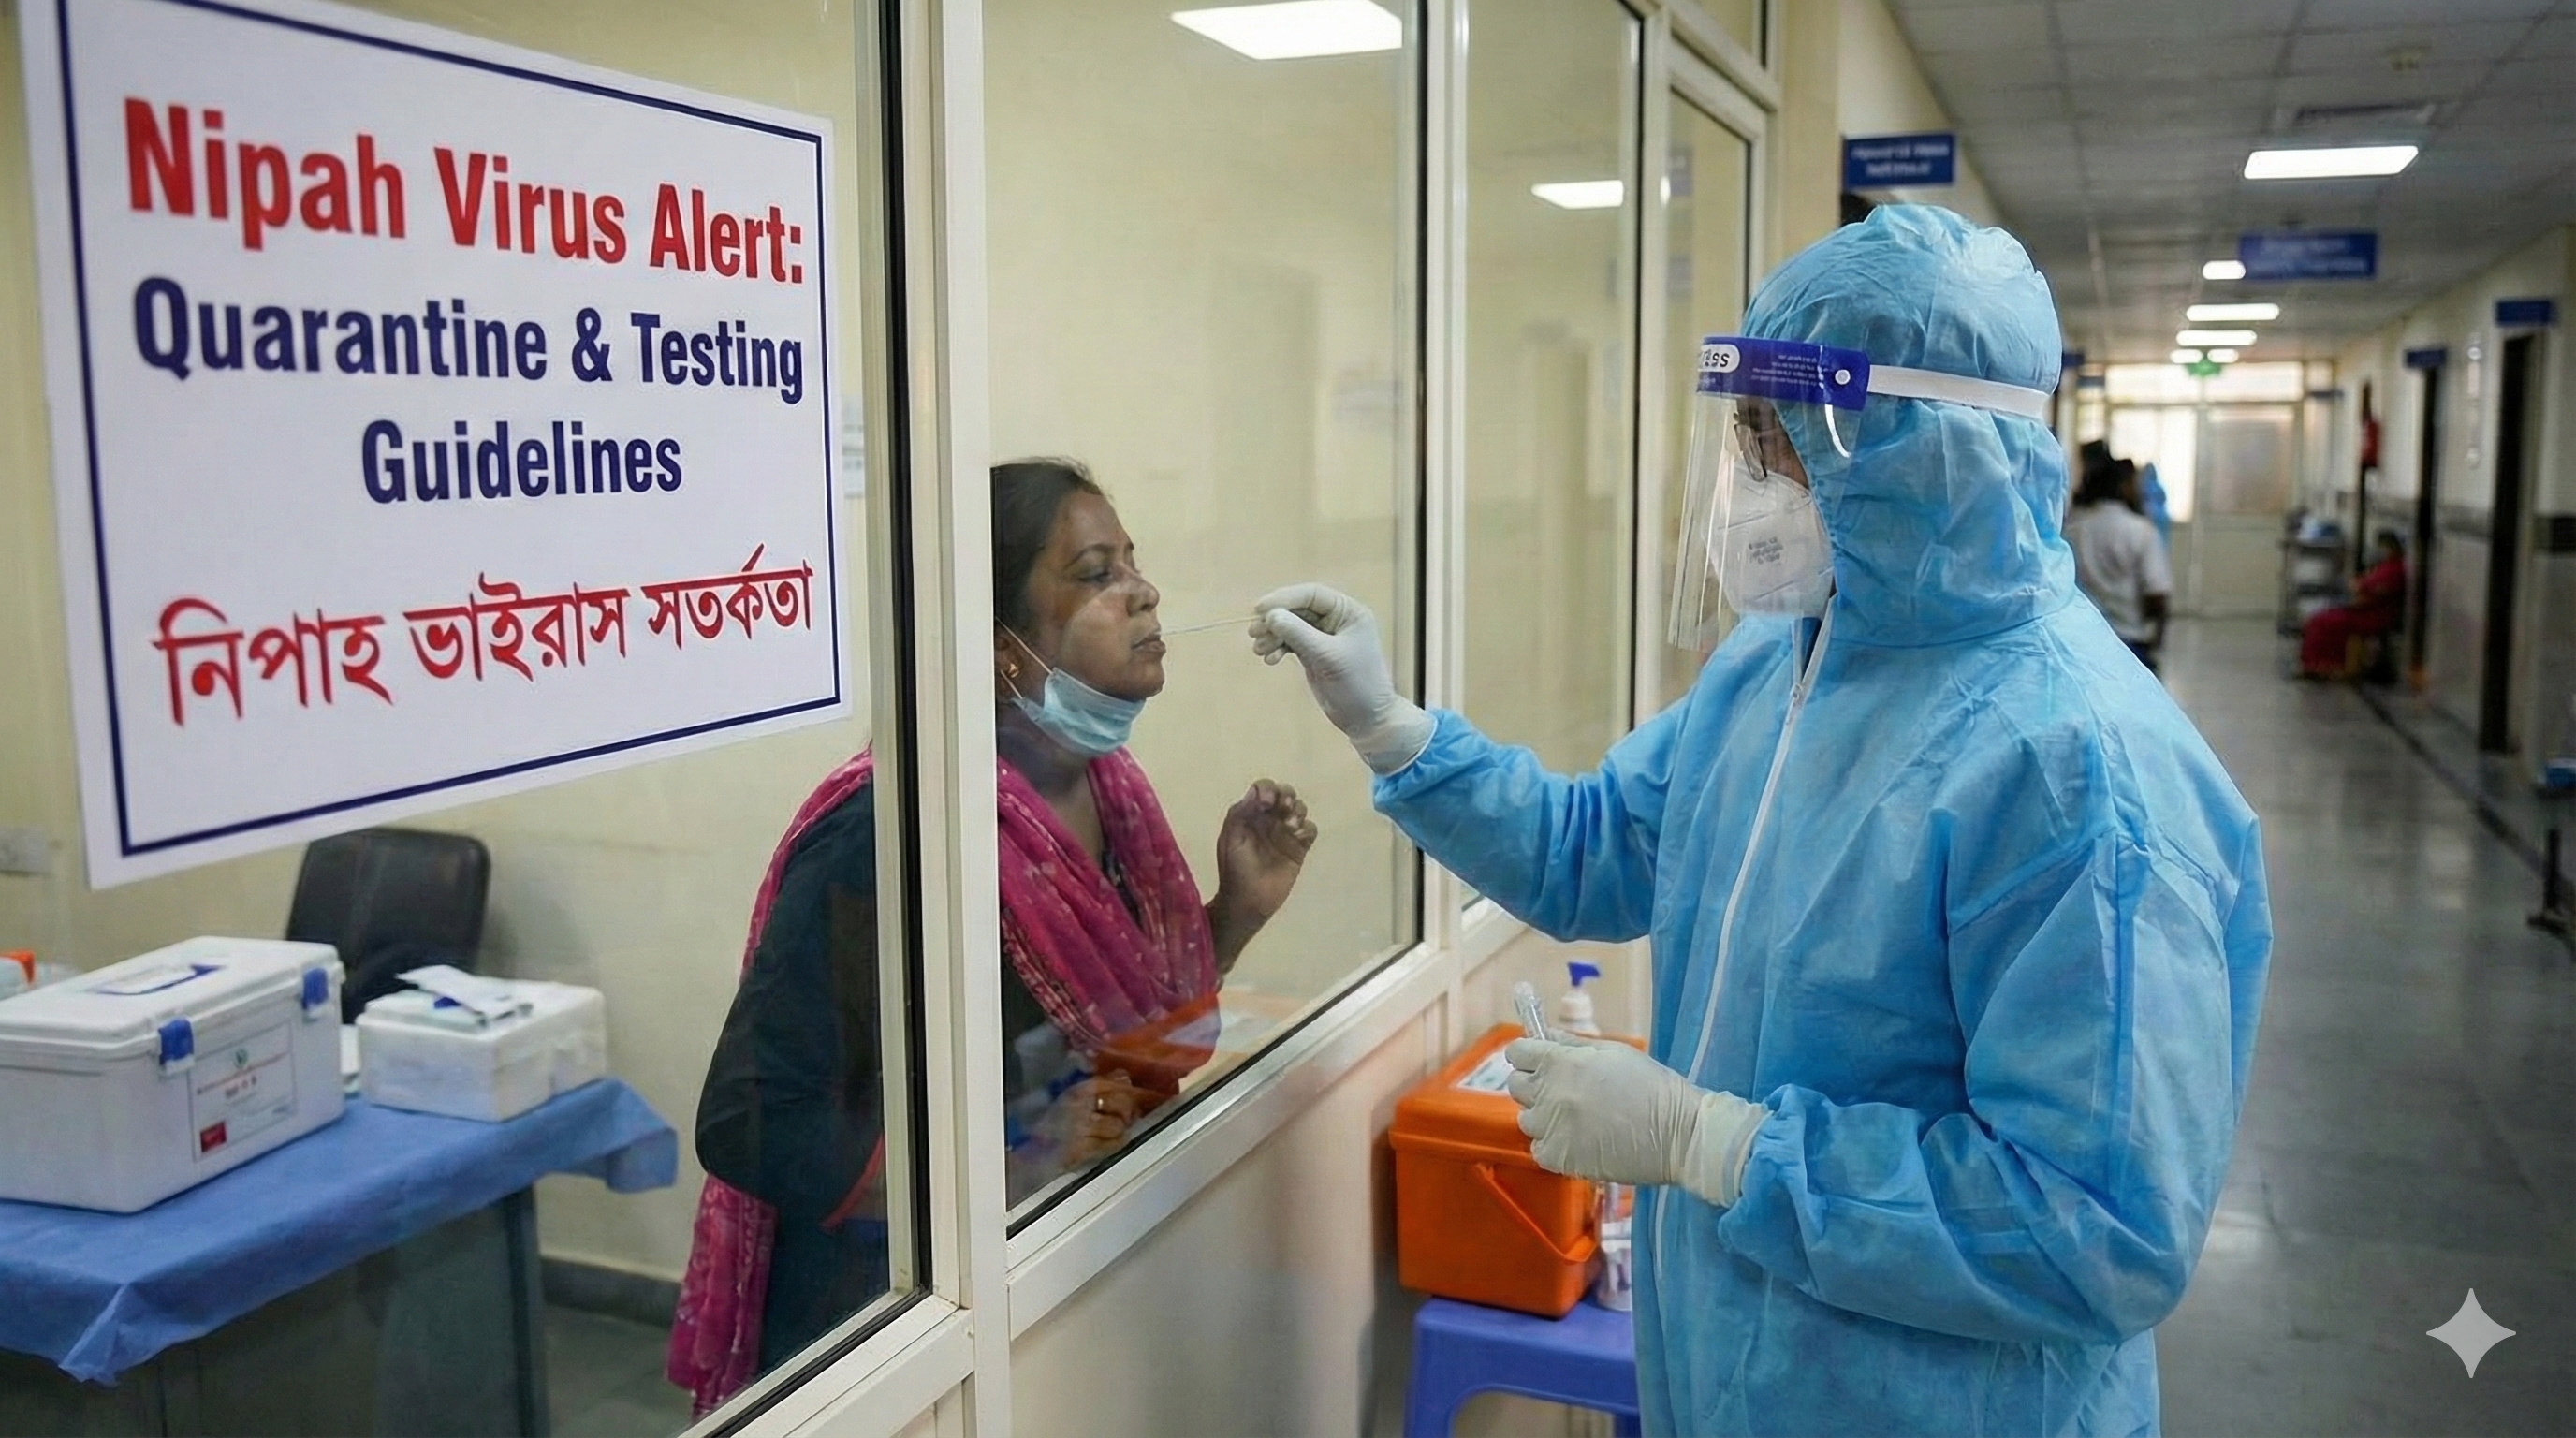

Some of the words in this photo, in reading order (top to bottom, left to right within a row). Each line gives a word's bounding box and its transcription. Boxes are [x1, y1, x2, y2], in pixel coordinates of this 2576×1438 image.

[124, 97, 407, 252] Nipah
[434, 145, 628, 264] Virus
[650, 183, 804, 284] Alert:
[133, 276, 548, 381] Quarantine
[571, 307, 613, 383] &
[630, 313, 803, 404] Testing
[361, 419, 682, 505] Guidelines
[154, 595, 393, 726] নিপাহ
[403, 573, 630, 682] ভাইরাস
[641, 544, 813, 649] সতর্কতা
